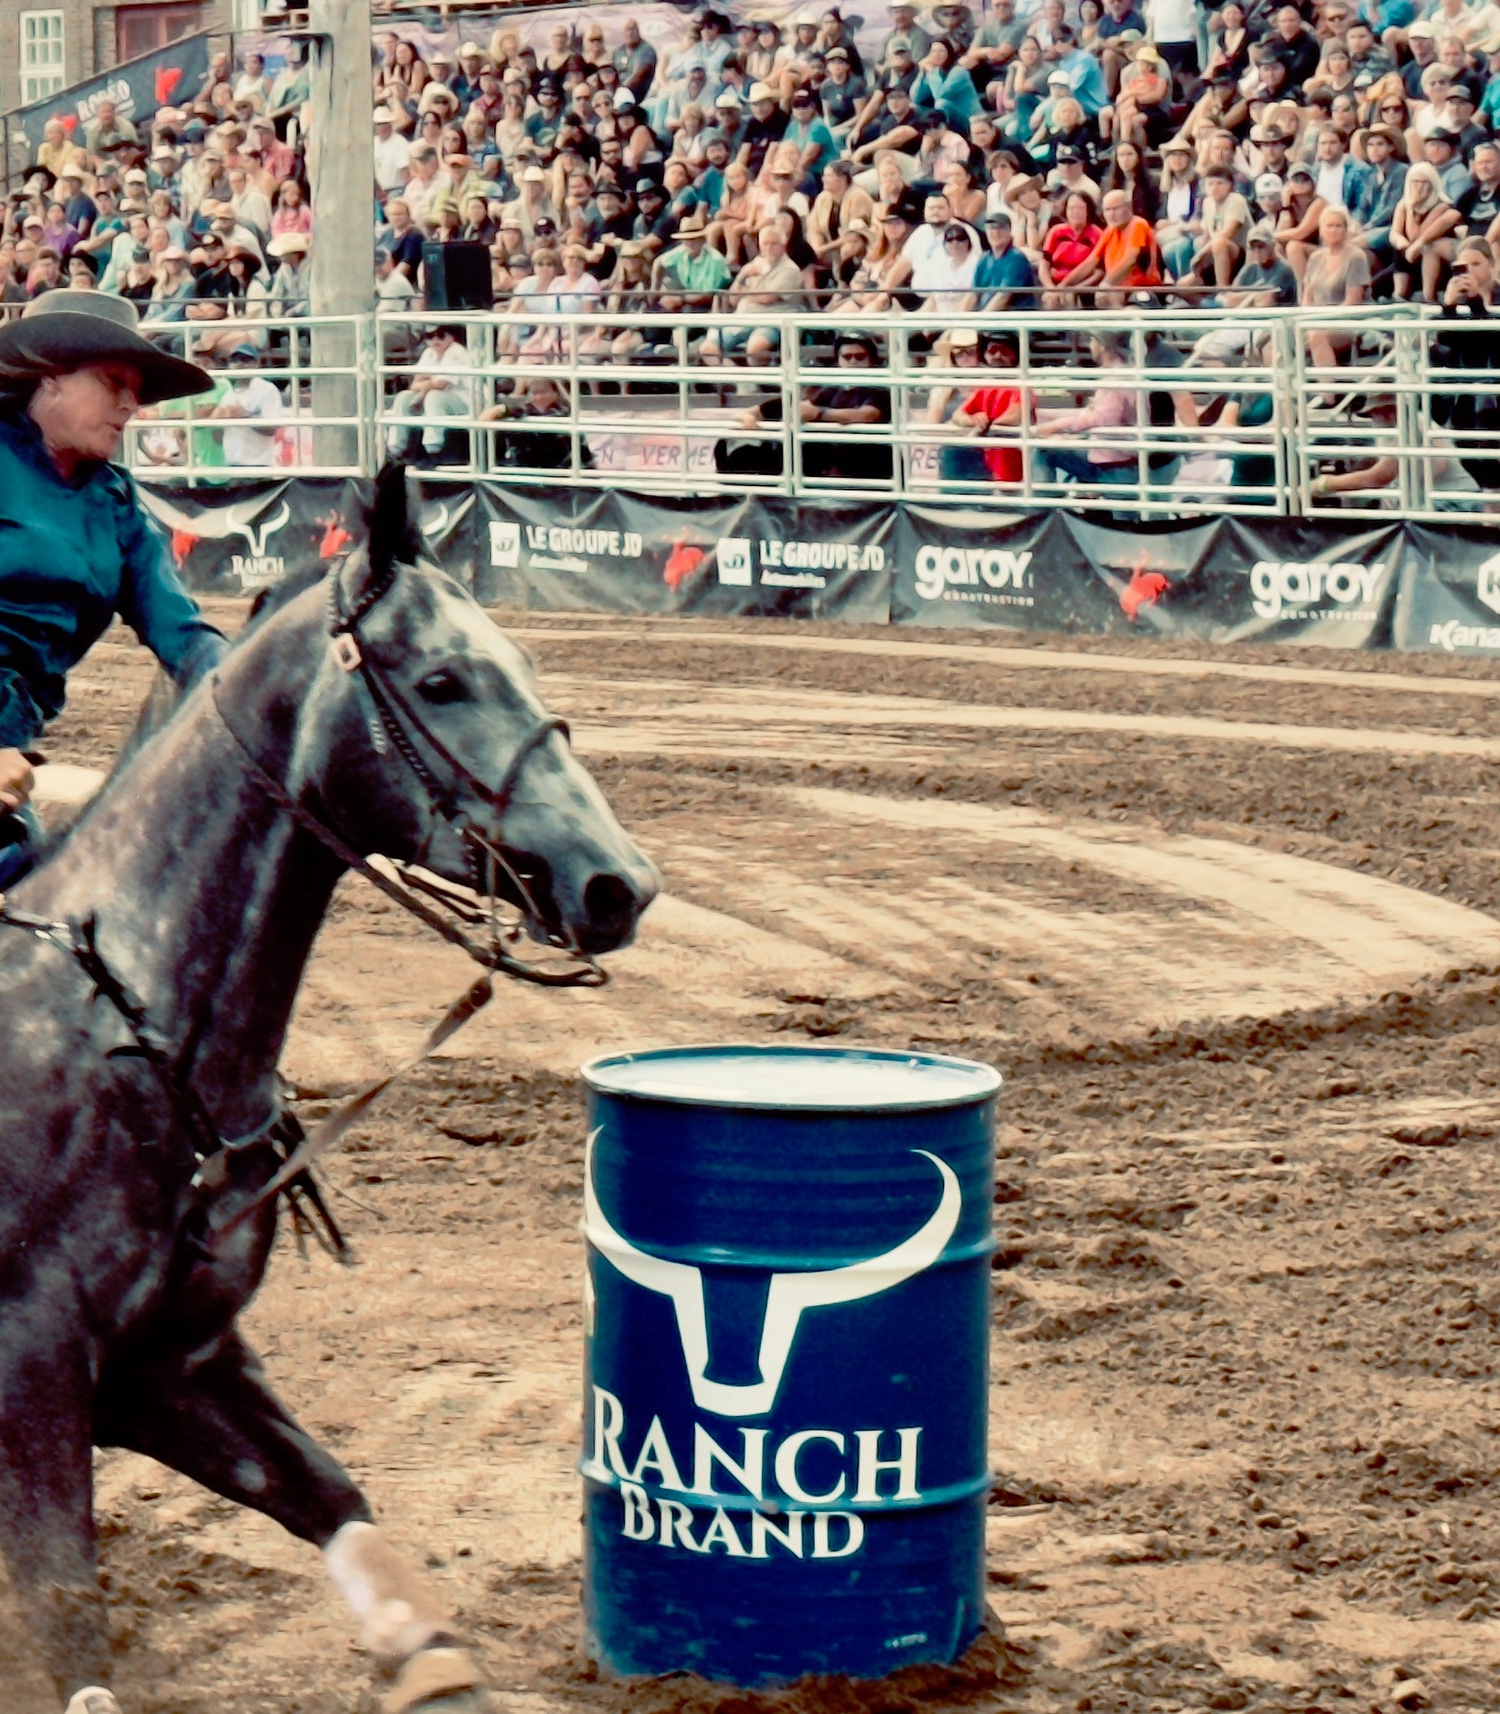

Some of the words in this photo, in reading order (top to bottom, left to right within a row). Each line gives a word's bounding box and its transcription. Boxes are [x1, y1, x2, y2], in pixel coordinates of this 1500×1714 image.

[525, 525, 548, 550] LE
[549, 527, 621, 556] GROUPE
[621, 532, 643, 558] JD
[759, 539, 784, 567] LE
[783, 541, 859, 570] GROUPE
[858, 545, 885, 571] JD
[230, 555, 285, 577] RANCH
[591, 1384, 924, 1504] RANCH
[619, 1480, 865, 1560] BRAND
